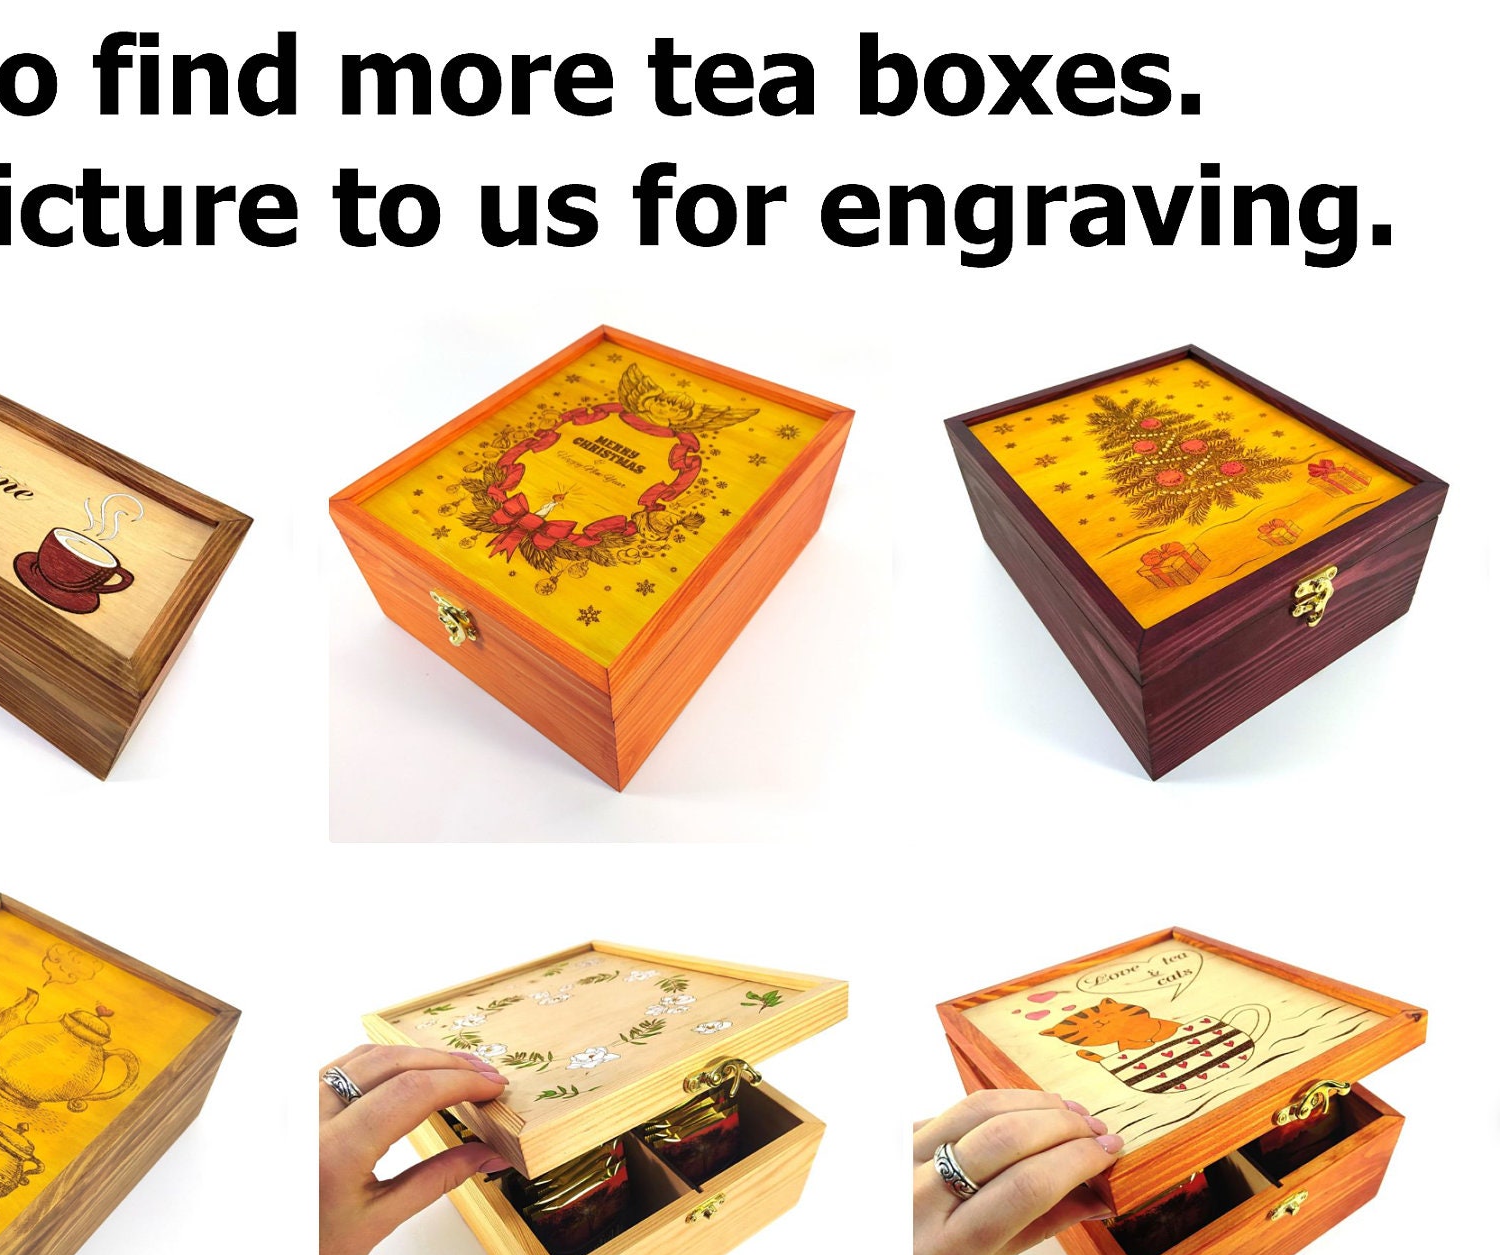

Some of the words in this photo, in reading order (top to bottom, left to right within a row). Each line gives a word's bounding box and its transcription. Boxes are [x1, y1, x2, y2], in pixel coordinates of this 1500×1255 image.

[572, 436, 646, 475] CHRISTMAS
[594, 435, 640, 459] MERRY
[1084, 964, 1140, 989] Love
[1162, 952, 1188, 965] tea
[1157, 968, 1194, 986] cats
